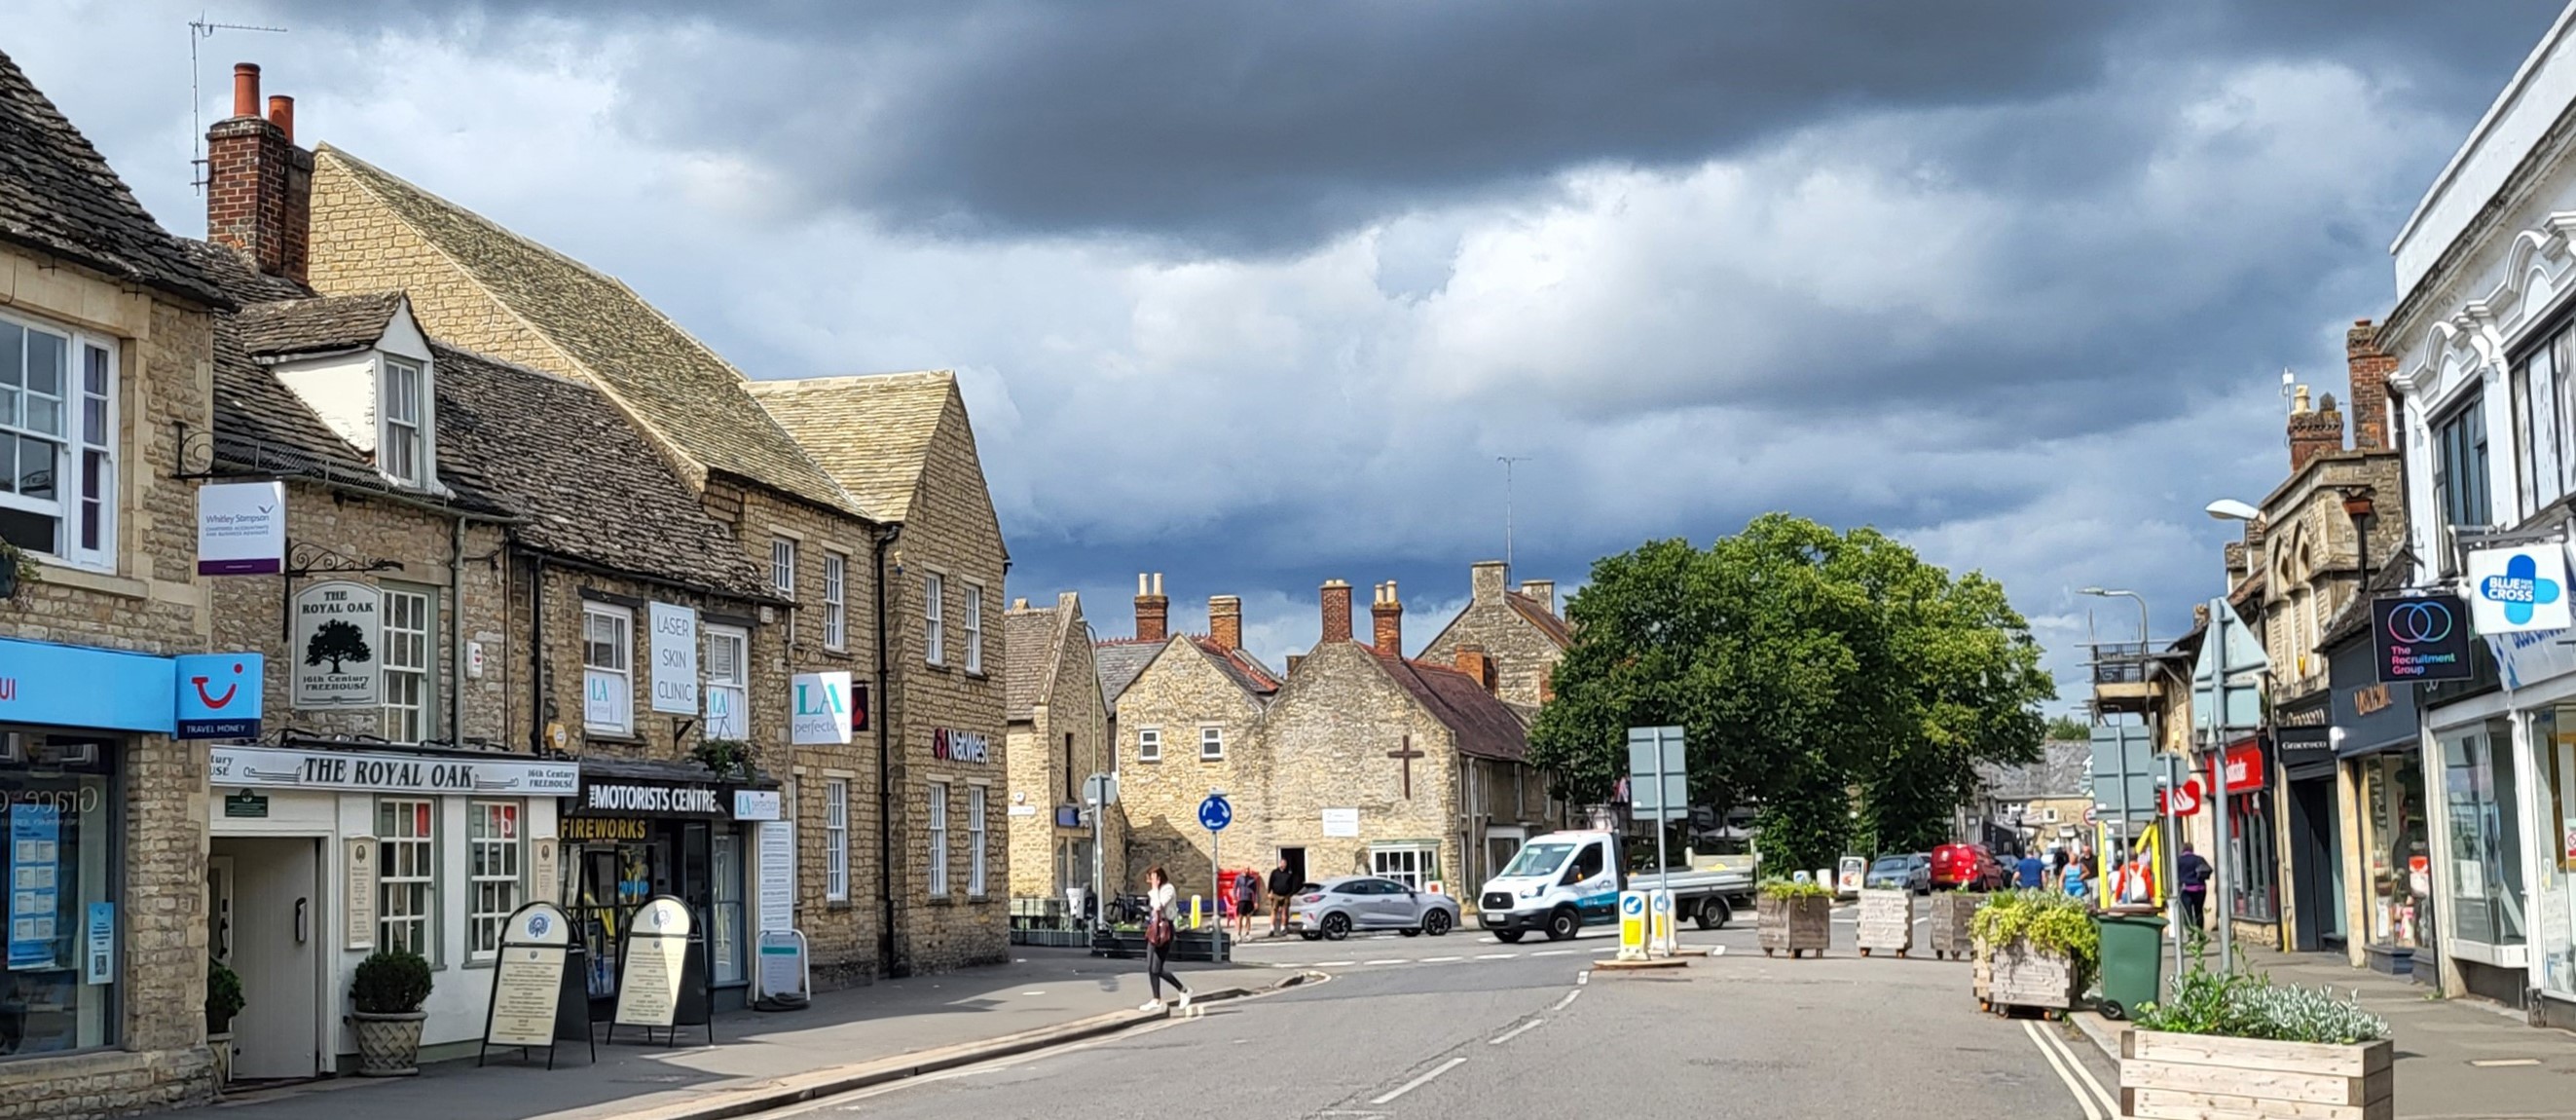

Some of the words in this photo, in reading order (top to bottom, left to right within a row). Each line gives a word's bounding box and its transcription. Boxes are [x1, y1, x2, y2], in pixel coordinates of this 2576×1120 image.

[205, 514, 235, 525] Whitley
[2488, 576, 2521, 590] BLUE
[323, 590, 348, 602] THE
[2487, 587, 2534, 602] CROSS
[302, 603, 344, 615] ROYAL
[347, 602, 374, 614] OAK
[656, 615, 690, 638] LASER
[2391, 645, 2411, 655] The
[662, 648, 687, 669] SKIN
[2391, 652, 2456, 665] Recruitment
[2392, 665, 2425, 676] Group
[305, 682, 368, 691] FREEHOUSE
[327, 674, 370, 685] Century
[591, 678, 609, 702] LA
[657, 681, 693, 703] CLINIC
[712, 691, 727, 714] LA
[795, 683, 845, 716] LA
[186, 724, 214, 733] TRAVEL
[216, 724, 246, 733] MONEY
[794, 719, 848, 735] perfection
[947, 728, 989, 764] NatWest
[303, 757, 347, 783] THE
[353, 760, 423, 787] ROYAL
[431, 765, 475, 789] OAK
[528, 768, 544, 778] 16th
[545, 768, 576, 781] Century
[529, 778, 574, 789] FREEHOUSE
[595, 784, 670, 811] MOTORISTS
[671, 788, 718, 813] CENTRE
[737, 794, 752, 815] LA
[561, 817, 646, 840] FIREWORKS
